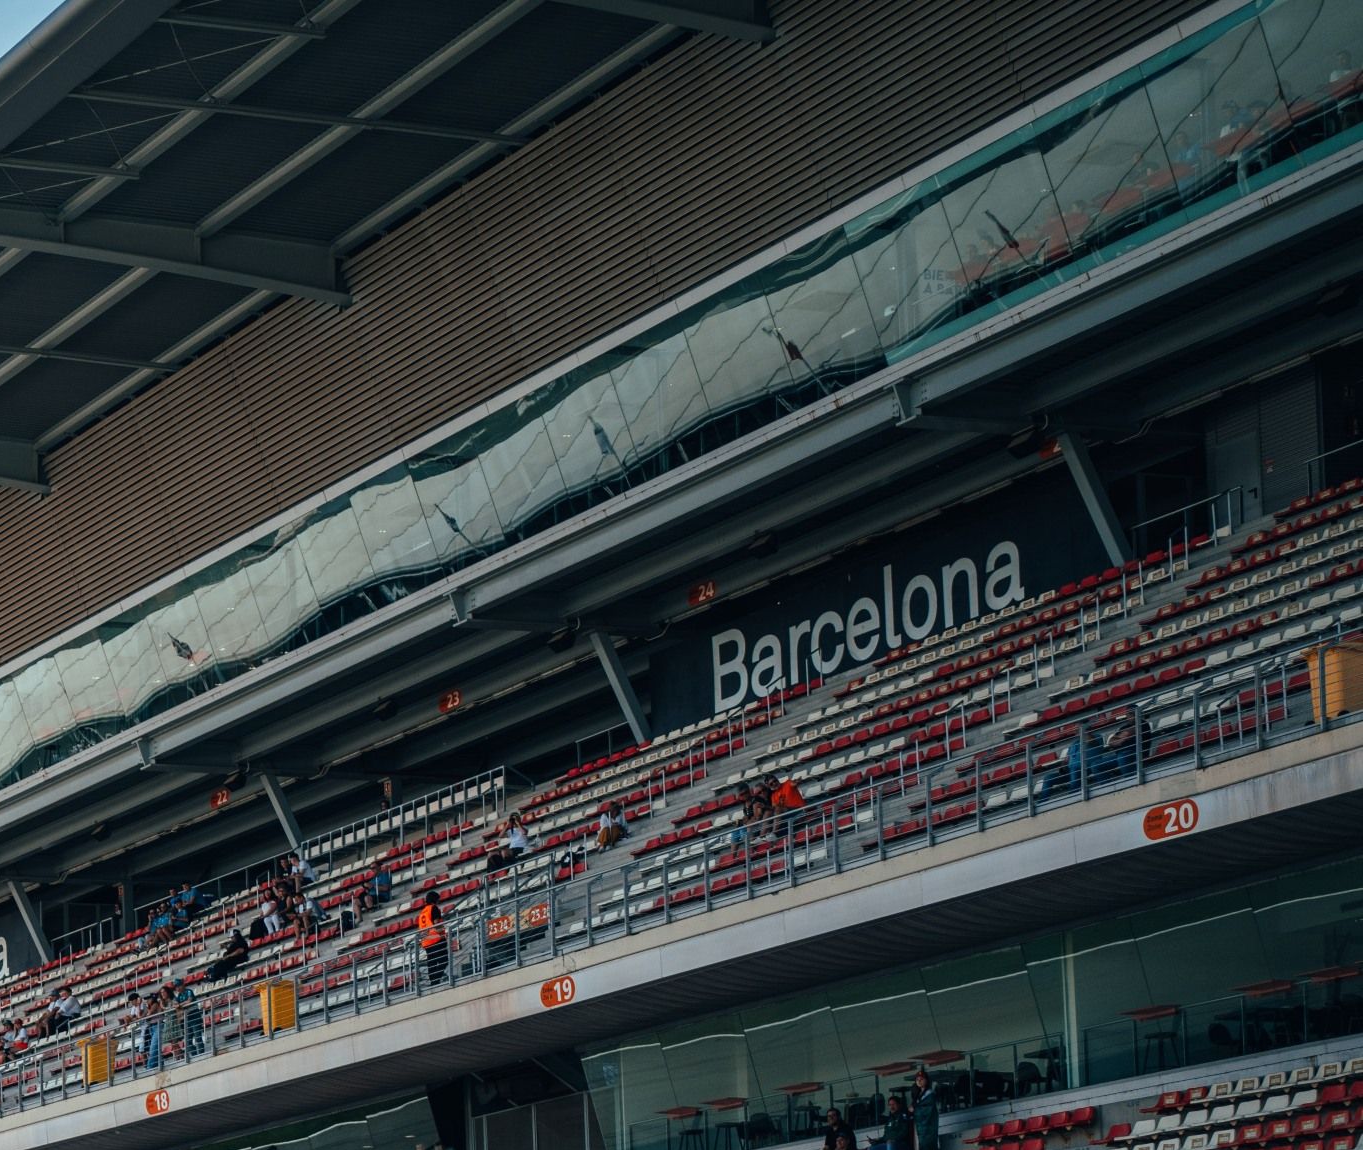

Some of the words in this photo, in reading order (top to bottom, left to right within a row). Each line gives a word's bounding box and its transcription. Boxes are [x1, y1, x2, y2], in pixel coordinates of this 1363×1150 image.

[698, 581, 714, 602] 24
[712, 541, 1025, 713] Barcelona
[447, 691, 459, 708] 23
[217, 790, 228, 805] 22
[1164, 803, 1194, 833] 20
[554, 979, 572, 1002] 19
[154, 1092, 168, 1111] 18
